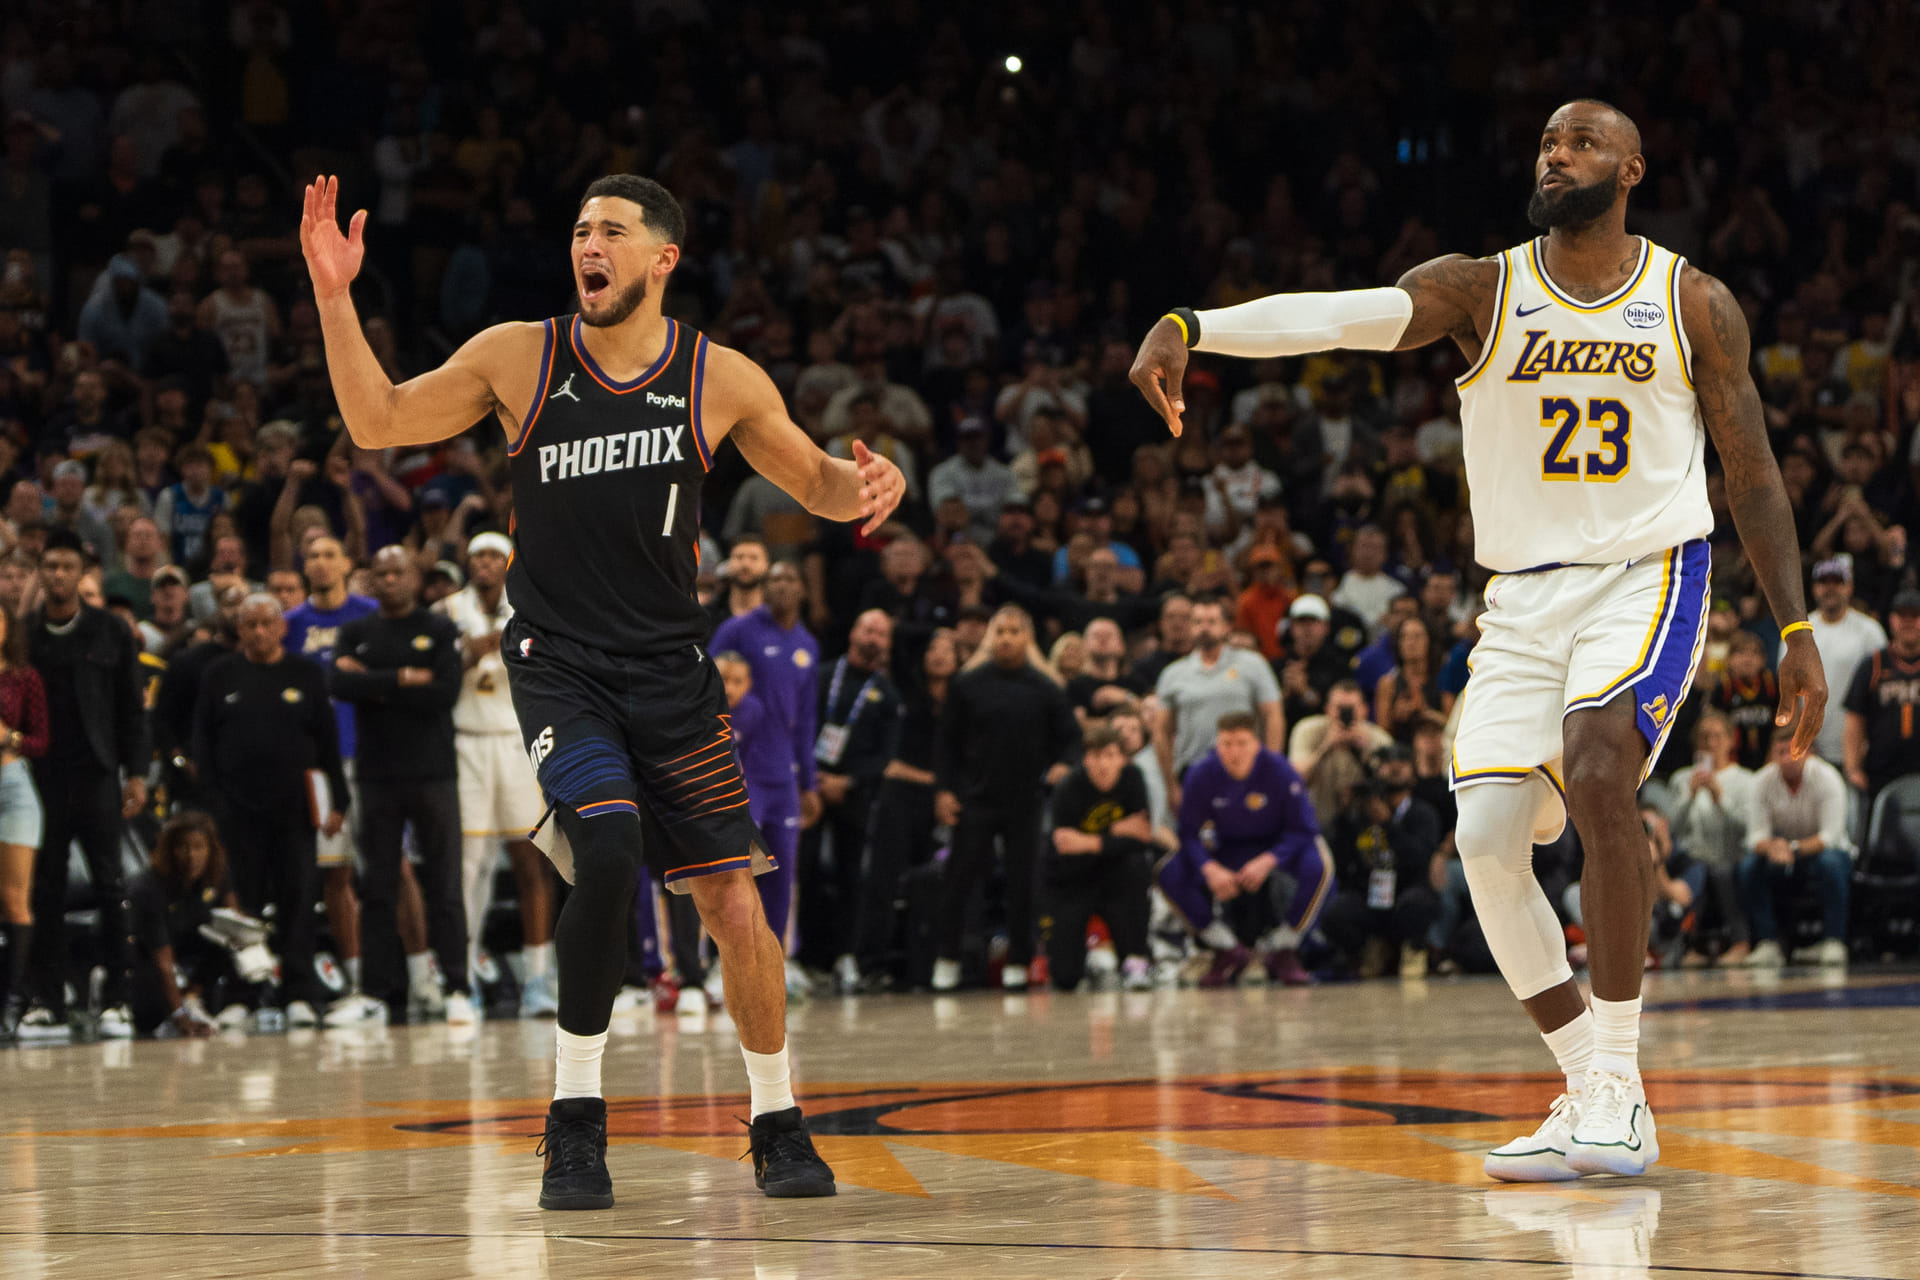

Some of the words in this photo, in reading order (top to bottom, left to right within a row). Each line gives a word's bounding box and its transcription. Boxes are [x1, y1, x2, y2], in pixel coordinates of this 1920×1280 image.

[1627, 308, 1662, 321] bibigo
[1506, 330, 1658, 383] LAKERS
[646, 392, 686, 408] PayPal
[538, 424, 685, 484] PHOENIX
[1540, 396, 1632, 483] 23
[662, 483, 678, 537] 1
